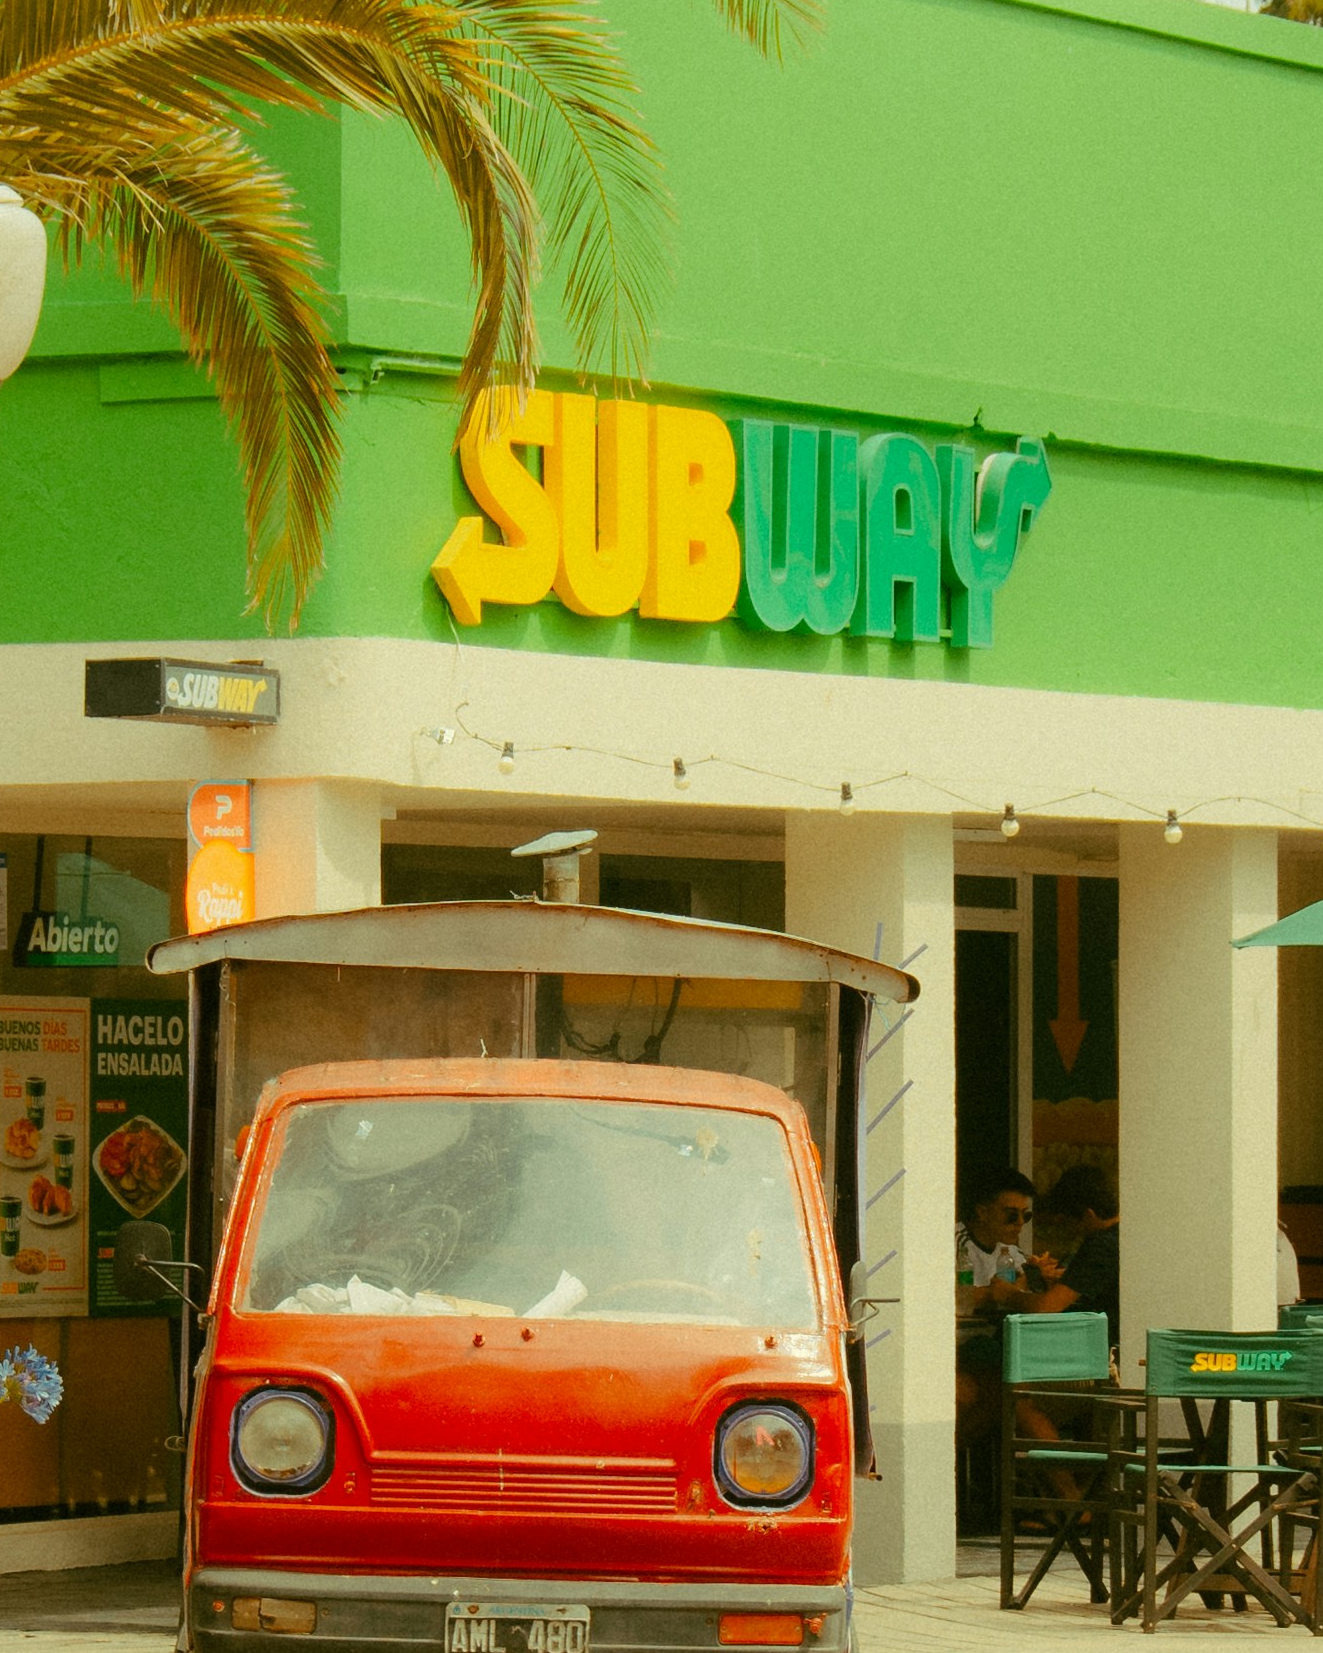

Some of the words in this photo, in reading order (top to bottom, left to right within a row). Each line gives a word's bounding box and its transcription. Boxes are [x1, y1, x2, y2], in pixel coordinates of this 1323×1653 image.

[430, 383, 1052, 649] SUBWAY
[177, 673, 268, 714] SUBWAY
[197, 890, 243, 926] Rappi
[28, 916, 119, 953] Abierto
[43, 1017, 68, 1035] DÍAS
[97, 1014, 184, 1045] HACELO
[41, 1037, 81, 1053] TARDES
[97, 1052, 184, 1076] ENSALADA
[1190, 1351, 1293, 1372] SUBWAY
[451, 1618, 507, 1653] AML
